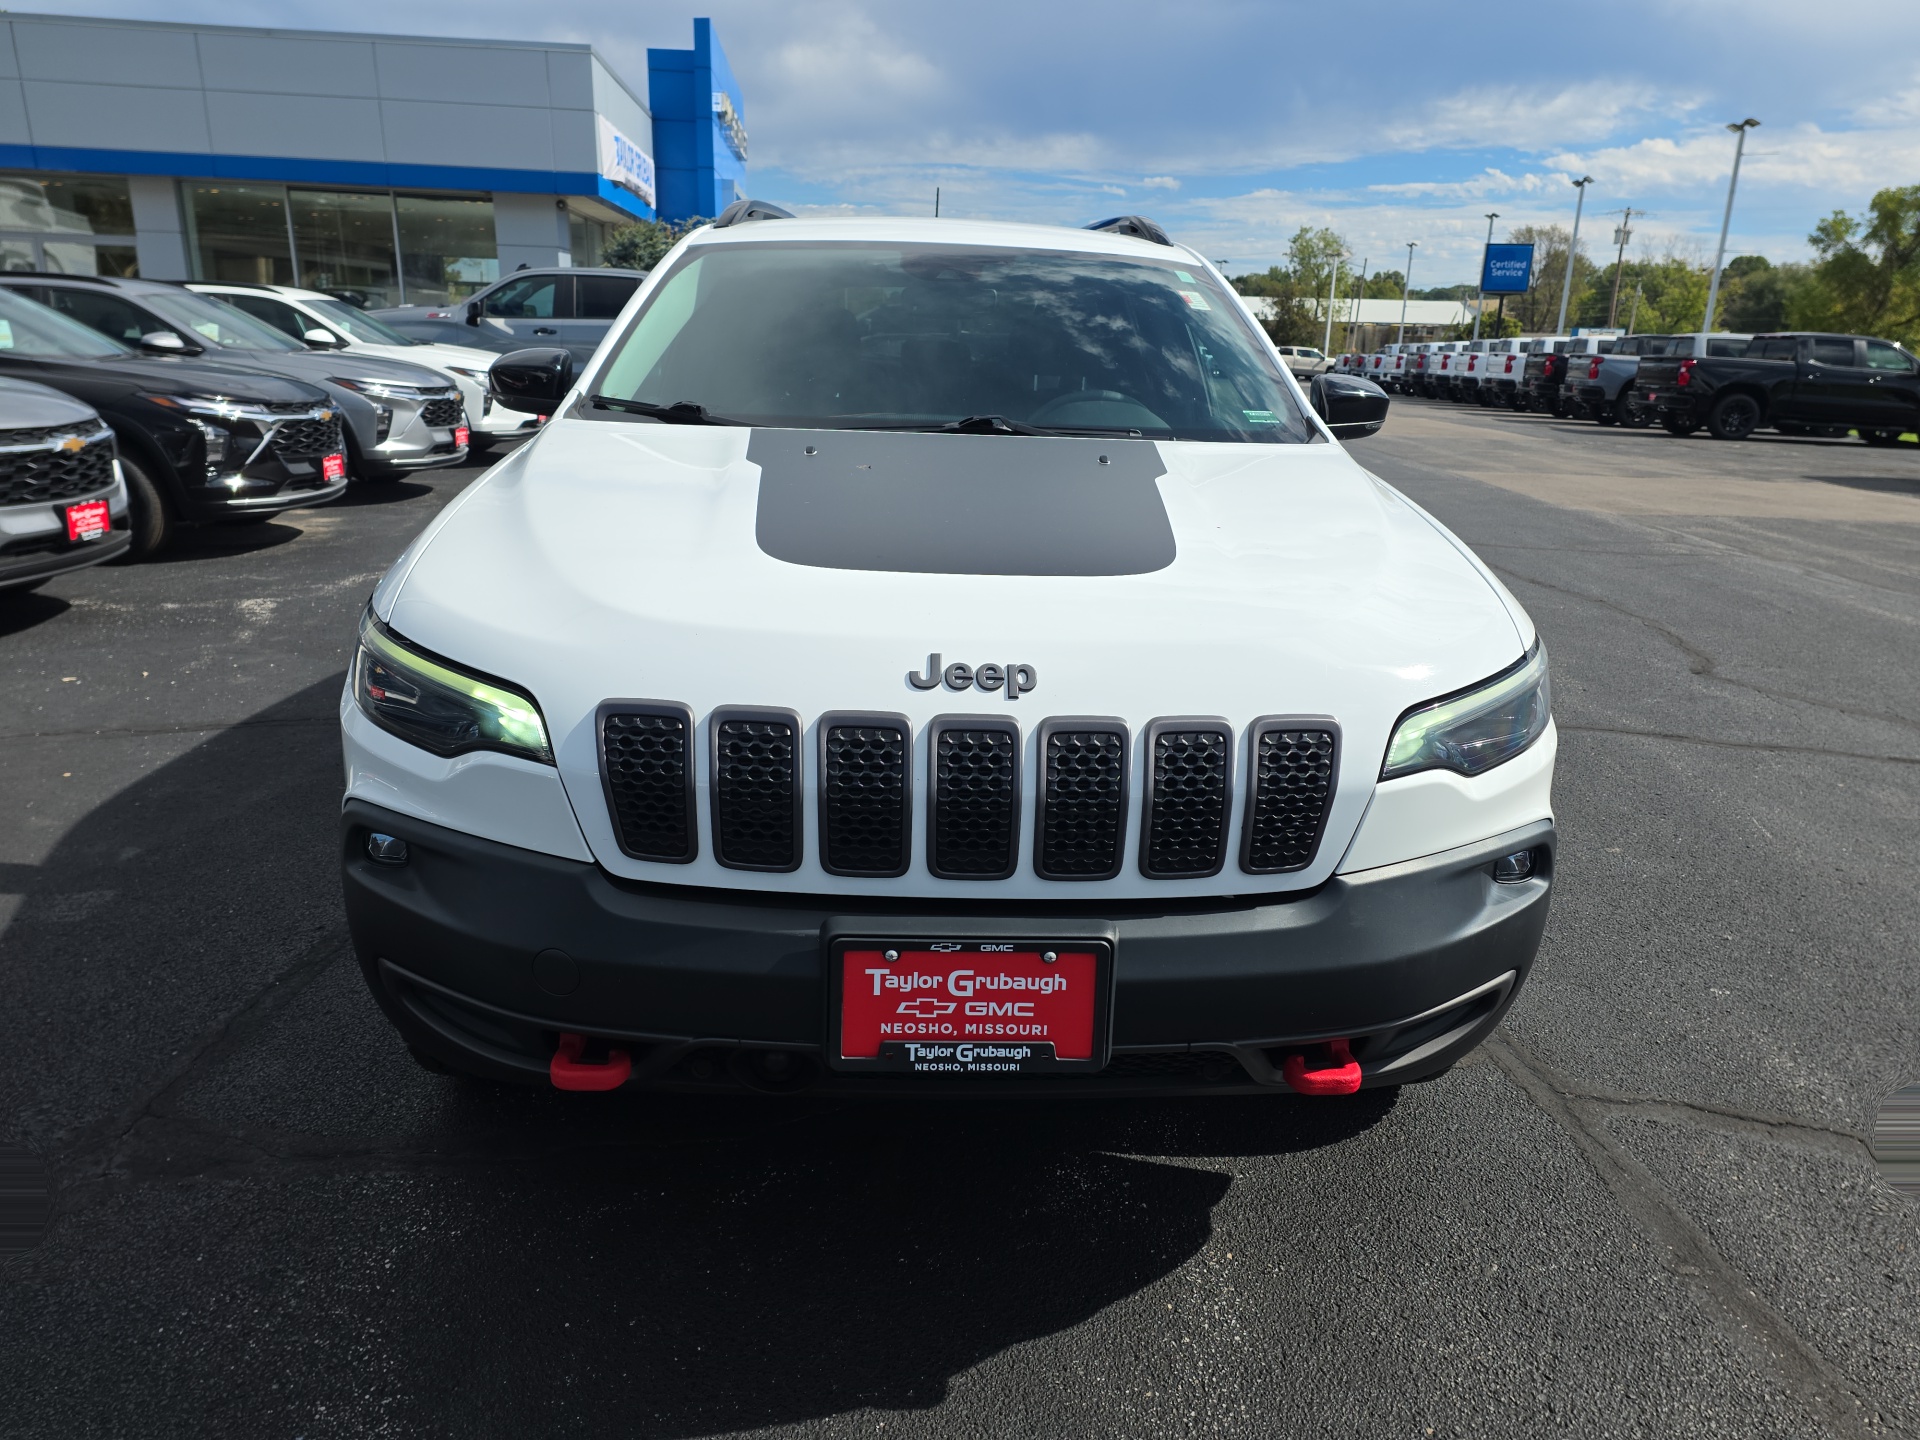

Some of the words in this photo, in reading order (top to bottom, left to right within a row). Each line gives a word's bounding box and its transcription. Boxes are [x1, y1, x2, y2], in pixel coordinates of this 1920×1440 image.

[1490, 260, 1527, 269] Certified
[1491, 268, 1523, 277] Service
[907, 652, 1038, 700] Jeep
[980, 944, 1014, 952] GMC
[864, 968, 943, 996] Taylor
[947, 969, 1067, 997] Grubaugh
[964, 1001, 1035, 1017] GMC
[880, 1023, 958, 1037] NEOSHO,
[965, 1024, 1048, 1036] MISSOURI
[904, 1043, 954, 1062] Taylor
[956, 1044, 1031, 1062] Grubaugh
[914, 1063, 964, 1073] NEOSHO,
[967, 1064, 1021, 1072] MISSOURI
